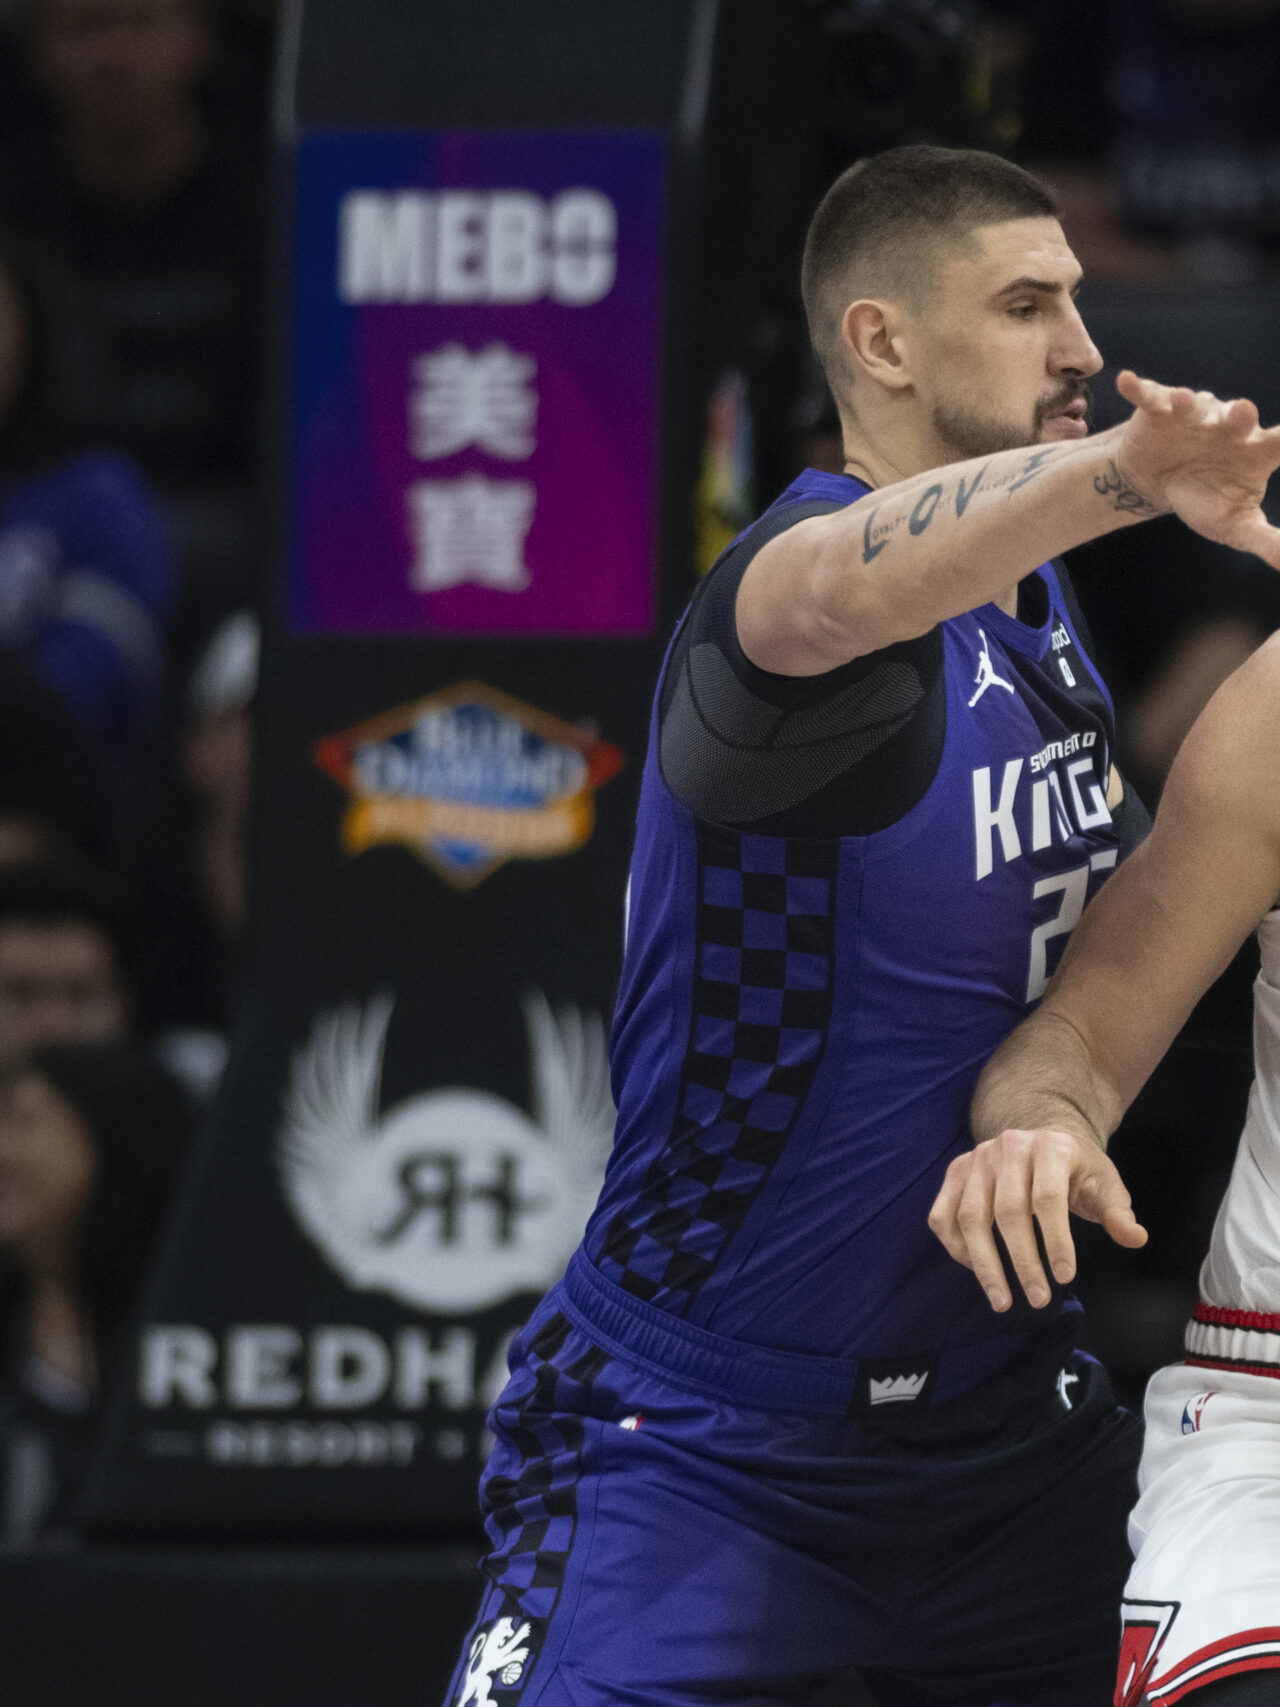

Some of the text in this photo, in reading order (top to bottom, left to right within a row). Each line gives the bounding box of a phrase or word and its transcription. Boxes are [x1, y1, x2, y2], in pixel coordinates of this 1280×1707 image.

[338, 189, 618, 306] MEBO
[973, 757, 1112, 882] KING
[1026, 849, 1119, 1004] 2
